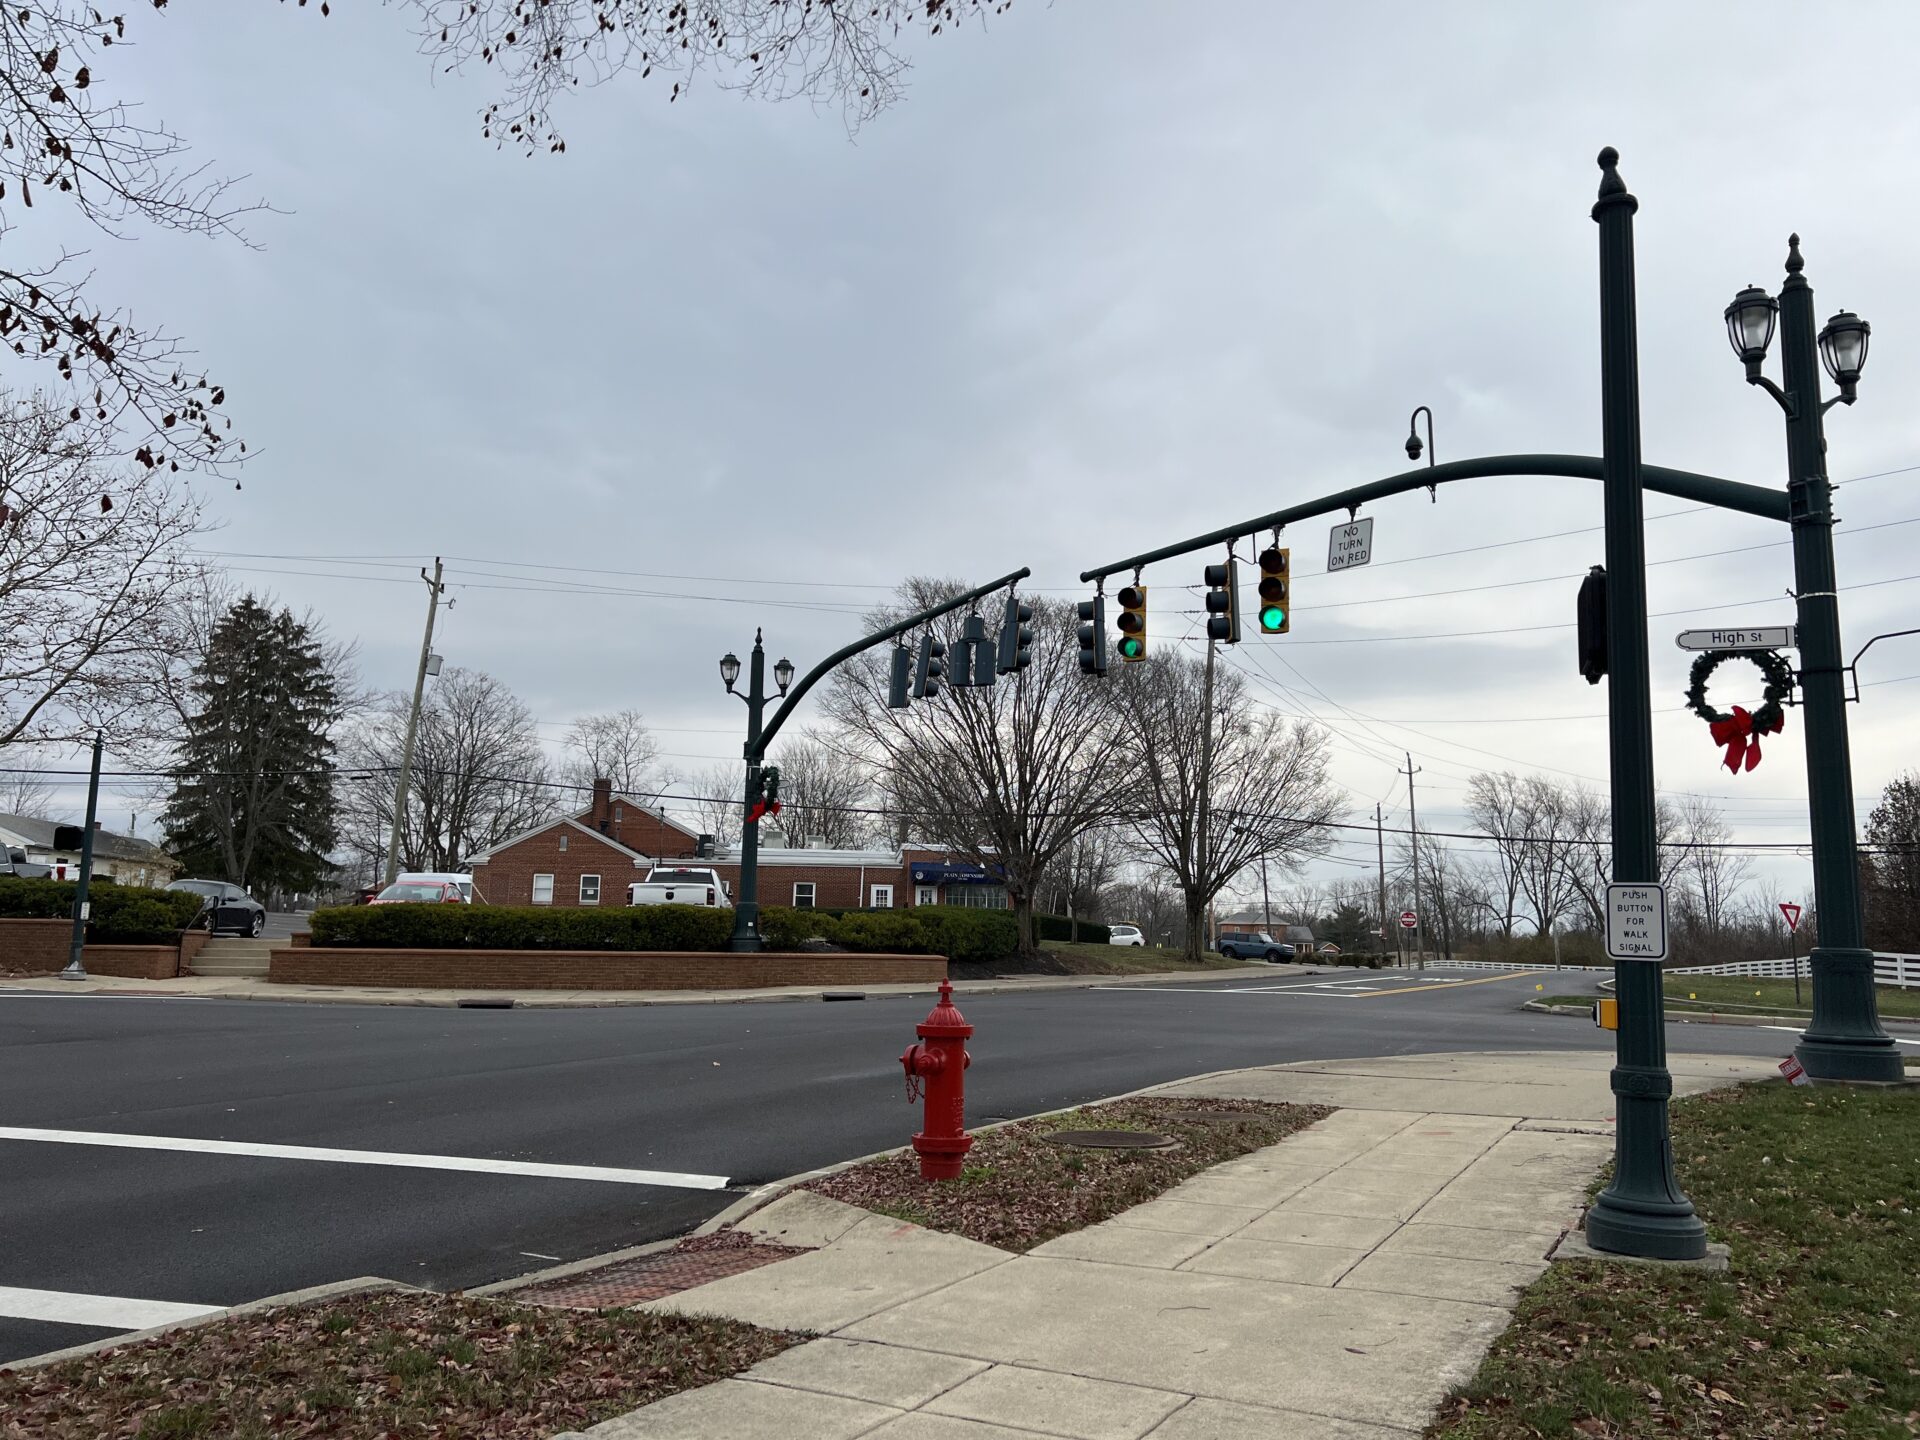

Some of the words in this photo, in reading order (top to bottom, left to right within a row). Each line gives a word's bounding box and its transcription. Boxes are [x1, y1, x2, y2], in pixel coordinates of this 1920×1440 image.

[1344, 527, 1358, 538] NO
[1338, 538, 1362, 551] TURN
[1331, 555, 1345, 566] ON
[1347, 550, 1367, 562] RED
[1712, 632, 1745, 646] High
[1750, 632, 1763, 642] St
